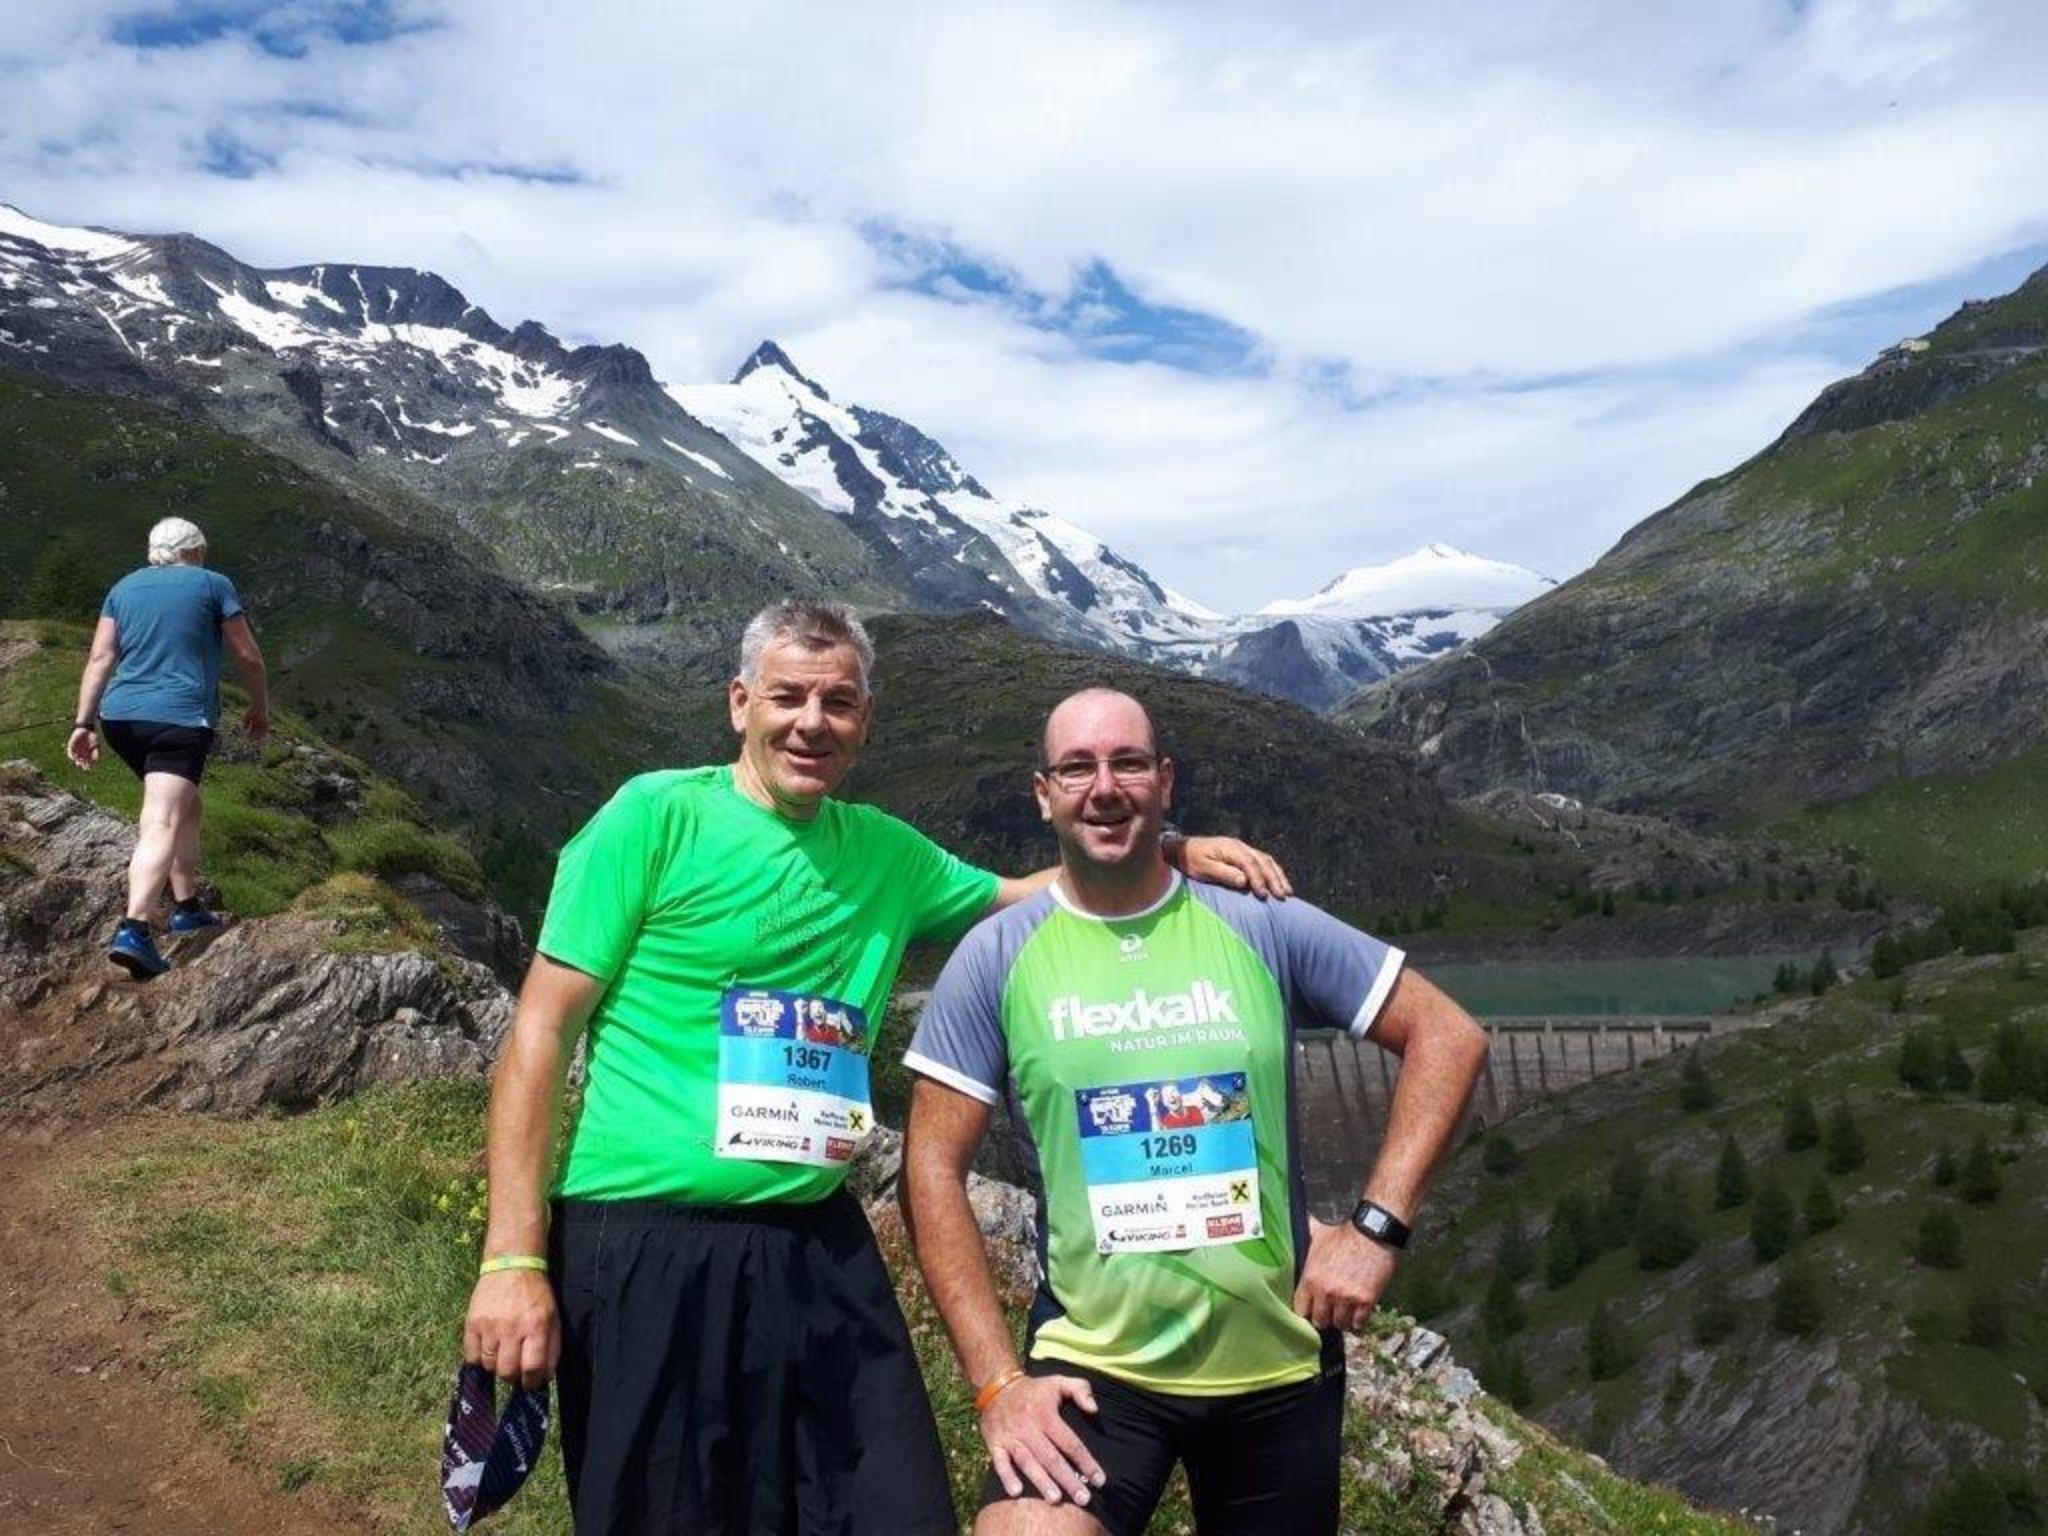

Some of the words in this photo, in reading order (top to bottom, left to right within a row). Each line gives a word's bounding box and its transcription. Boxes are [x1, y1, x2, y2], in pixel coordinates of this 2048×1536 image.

[1049, 980, 1239, 1041] flexkalk
[1110, 1036, 1168, 1053] NATUR
[1171, 1031, 1192, 1044] IM
[783, 1045, 832, 1071] 1367
[731, 1105, 799, 1122] GARMIN
[753, 1137, 798, 1150] VIKING
[1140, 1133, 1197, 1159] 1269
[1150, 1163, 1193, 1176] Marcel
[1101, 1201, 1168, 1217] GARMIN
